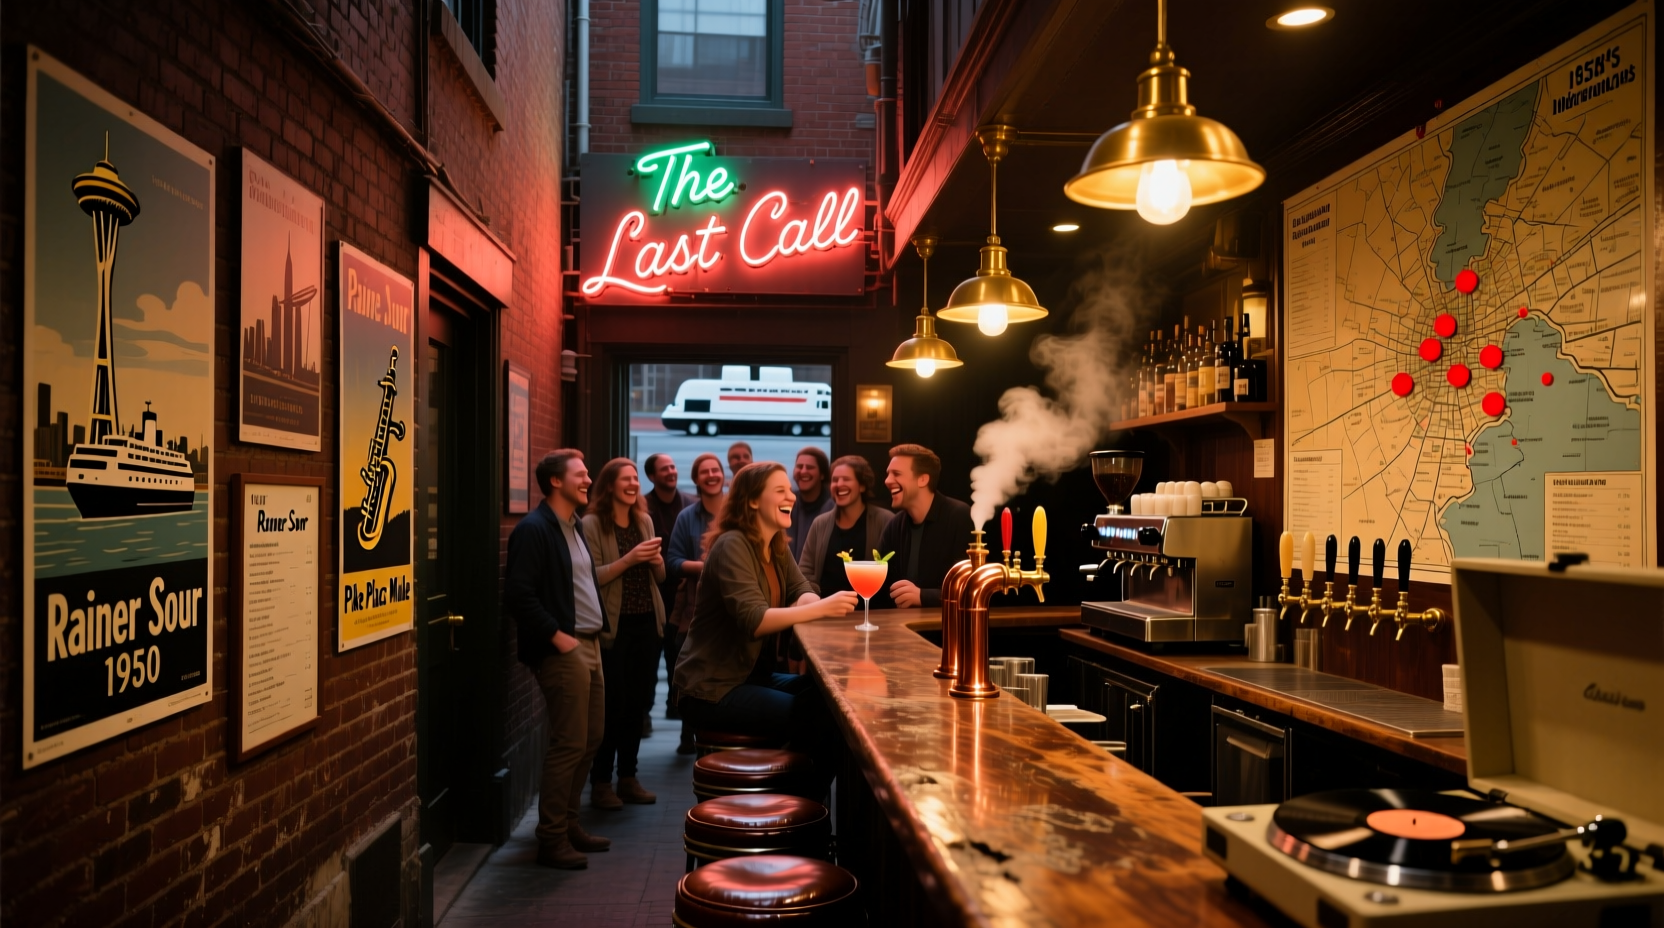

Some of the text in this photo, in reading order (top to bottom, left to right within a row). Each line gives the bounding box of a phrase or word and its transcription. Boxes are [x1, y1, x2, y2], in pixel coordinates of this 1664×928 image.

[637, 141, 735, 212] The
[582, 187, 860, 294] Last Call
[47, 576, 203, 662] Rainer Sour
[104, 645, 161, 697] 1950
